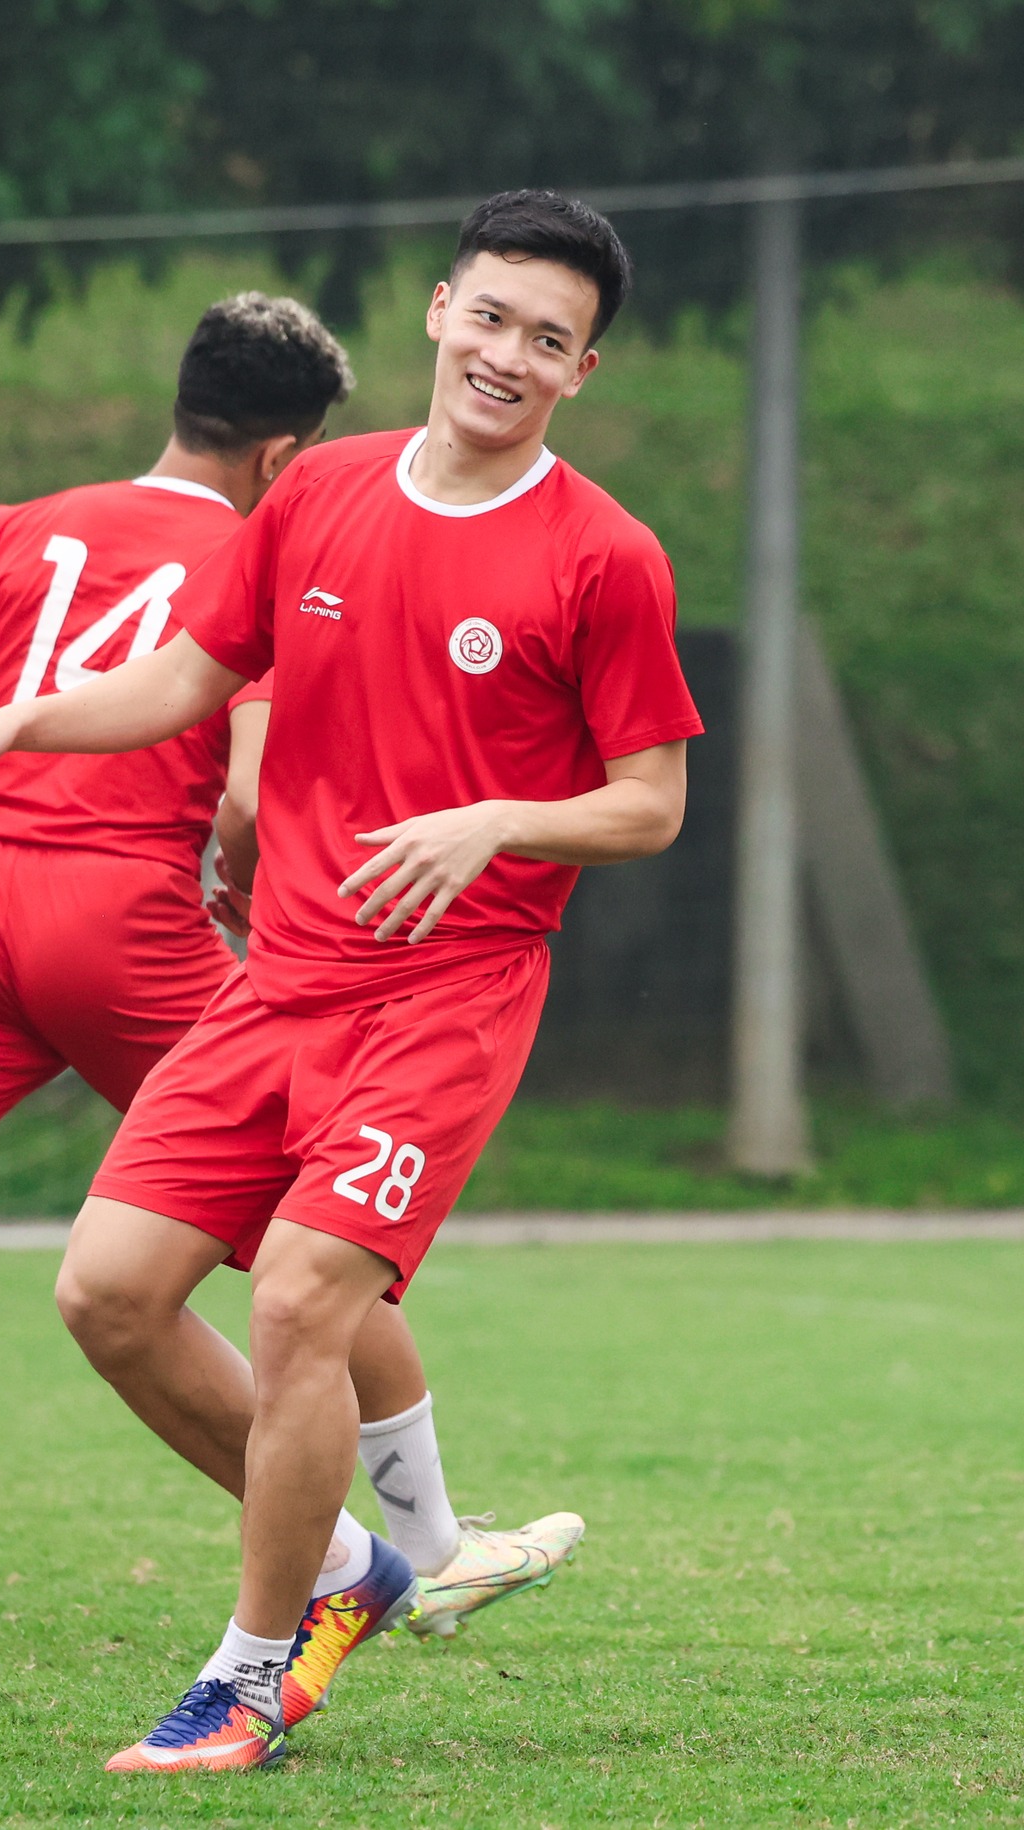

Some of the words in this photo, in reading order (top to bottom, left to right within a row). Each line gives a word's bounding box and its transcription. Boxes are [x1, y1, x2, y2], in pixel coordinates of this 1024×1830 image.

[11, 534, 186, 704] 14
[299, 602, 342, 620] LI-NING
[332, 1123, 426, 1222] 28
